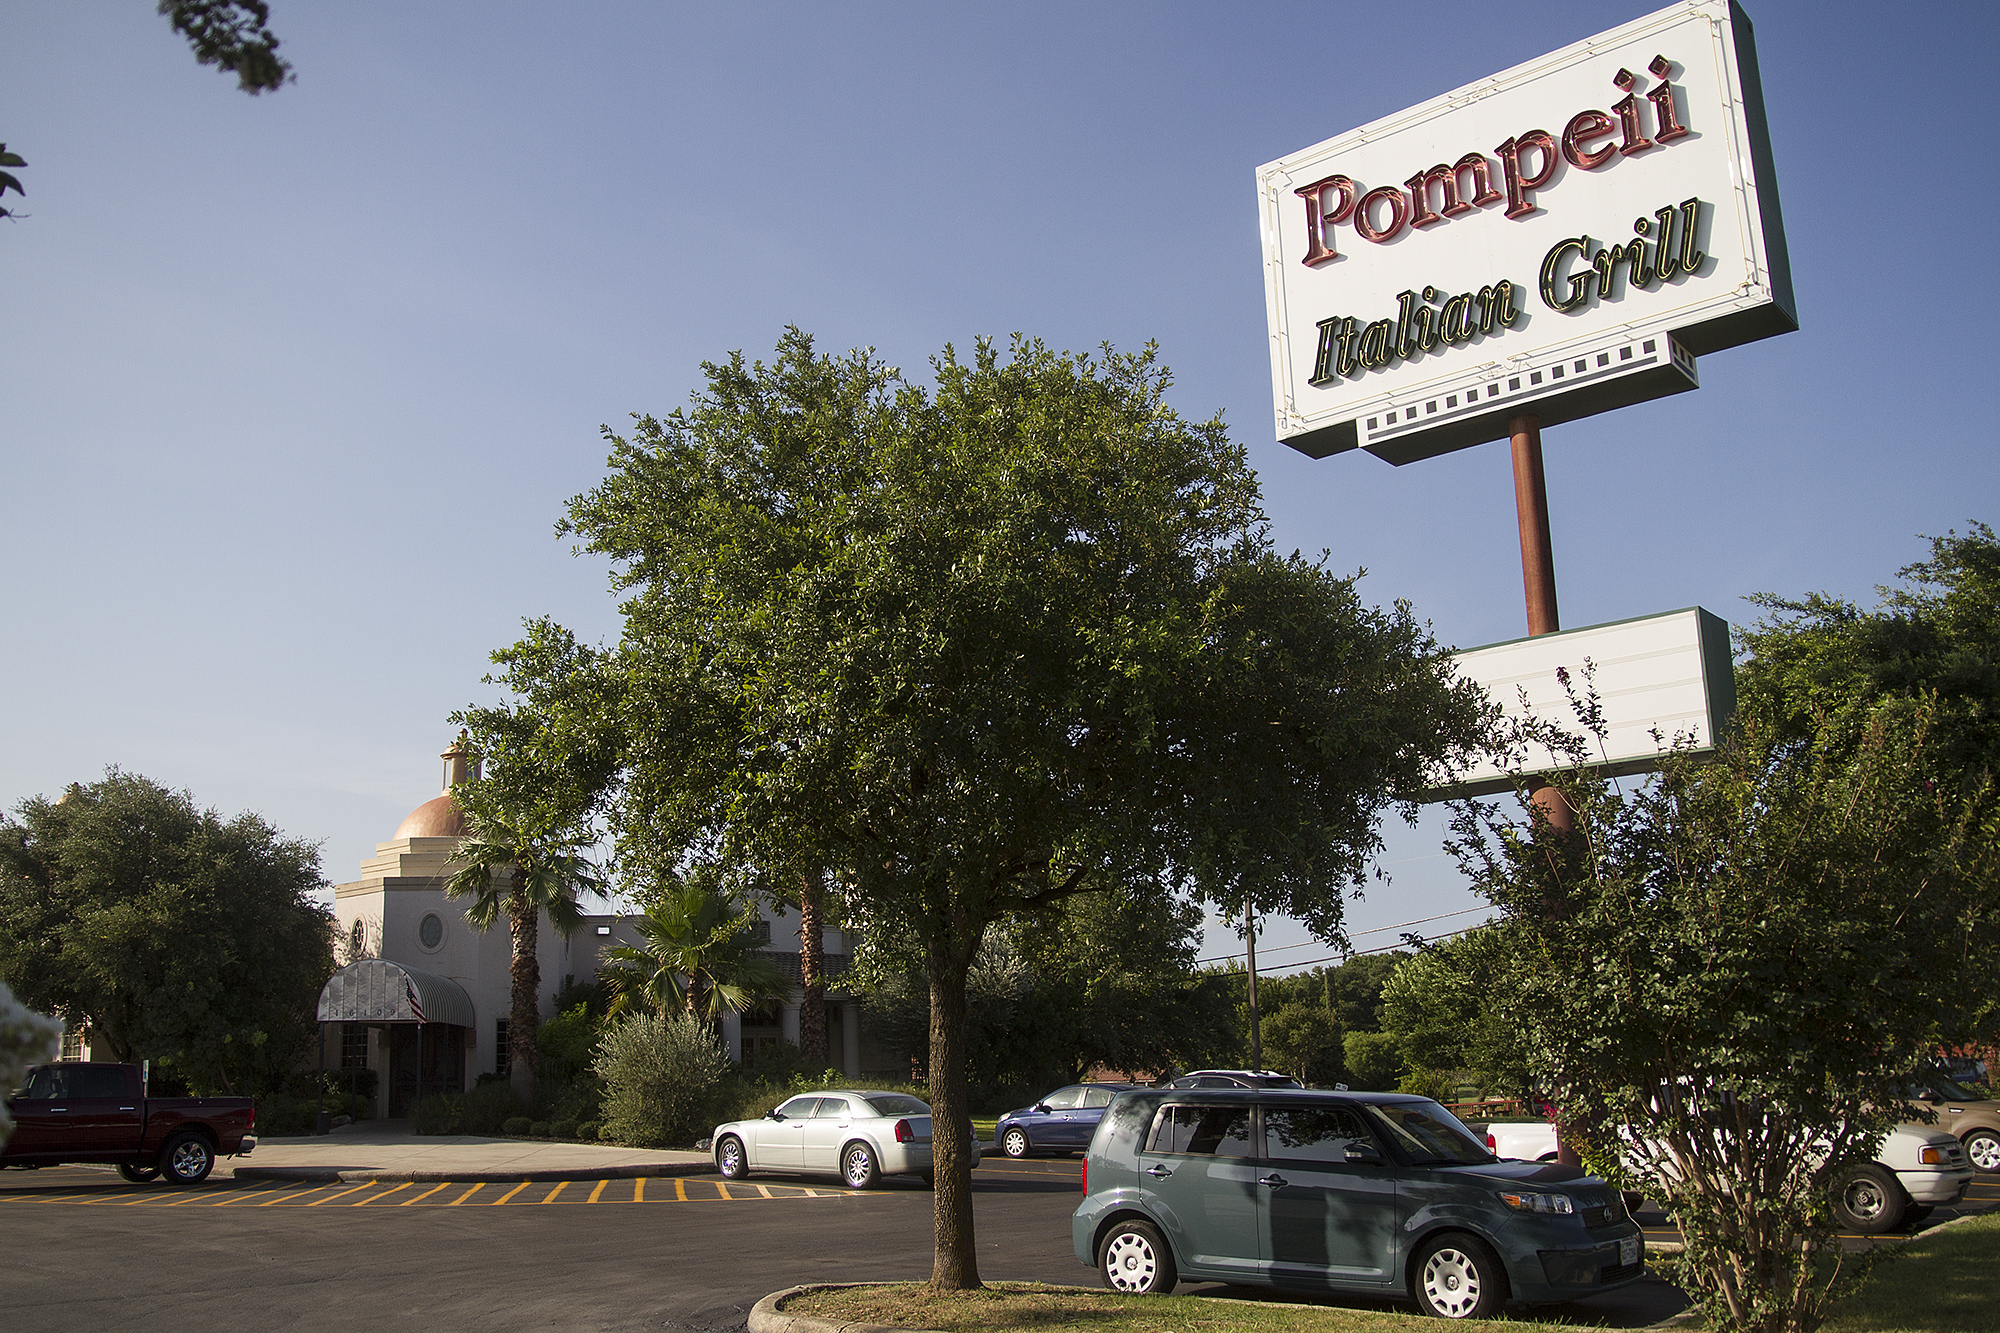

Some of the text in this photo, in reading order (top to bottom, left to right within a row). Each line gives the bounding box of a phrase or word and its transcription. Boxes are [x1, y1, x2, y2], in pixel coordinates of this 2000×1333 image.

[1294, 54, 1689, 267] Pompeii
[1308, 197, 1703, 387] Italian Grill
[335, 1009, 396, 1017] 16109
